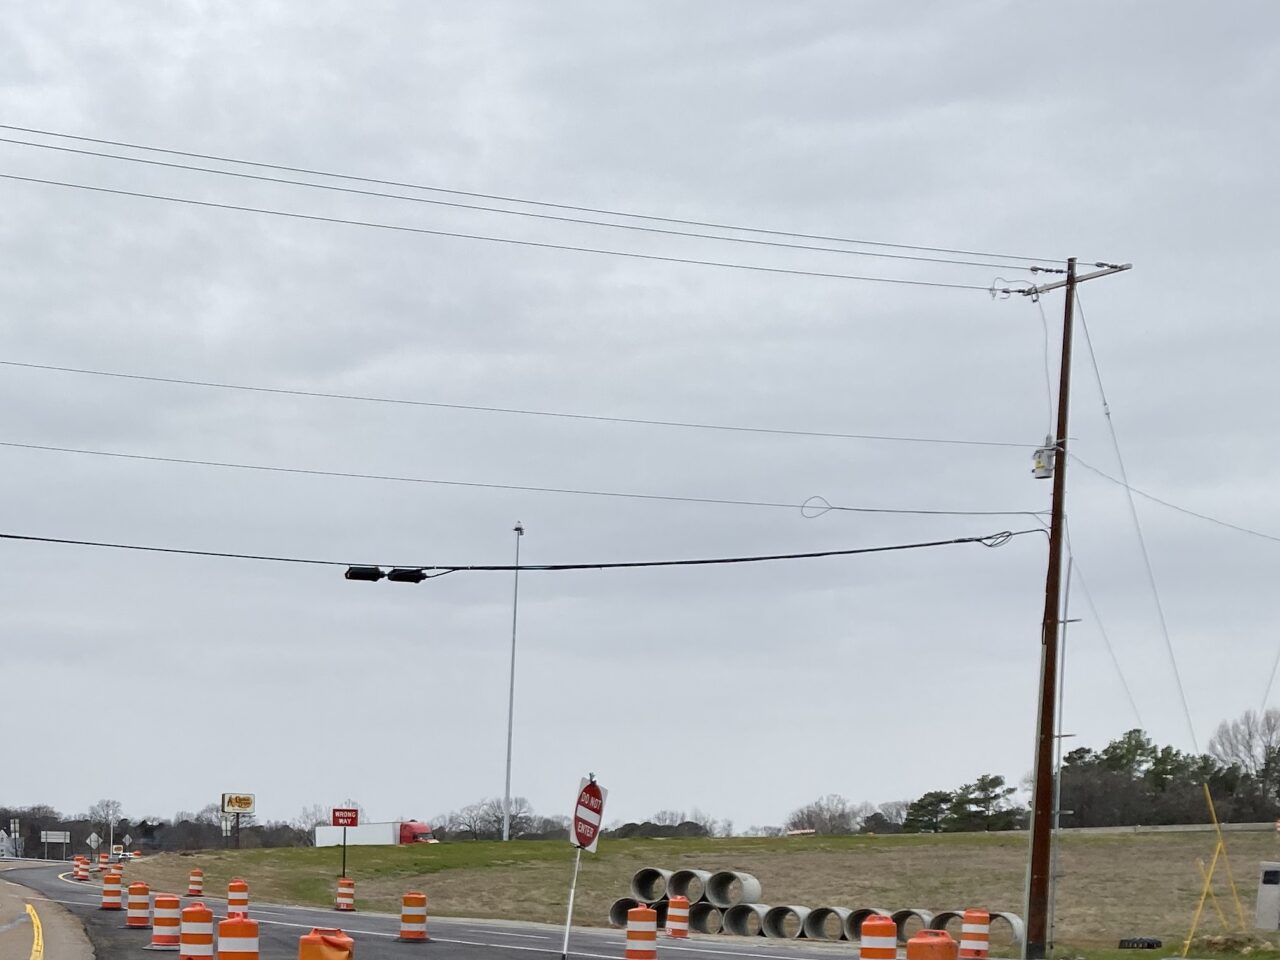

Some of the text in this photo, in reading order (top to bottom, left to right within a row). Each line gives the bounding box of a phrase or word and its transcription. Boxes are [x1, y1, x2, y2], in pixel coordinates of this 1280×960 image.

[581, 791, 601, 809] DO NOT
[577, 821, 594, 838] ENTER
